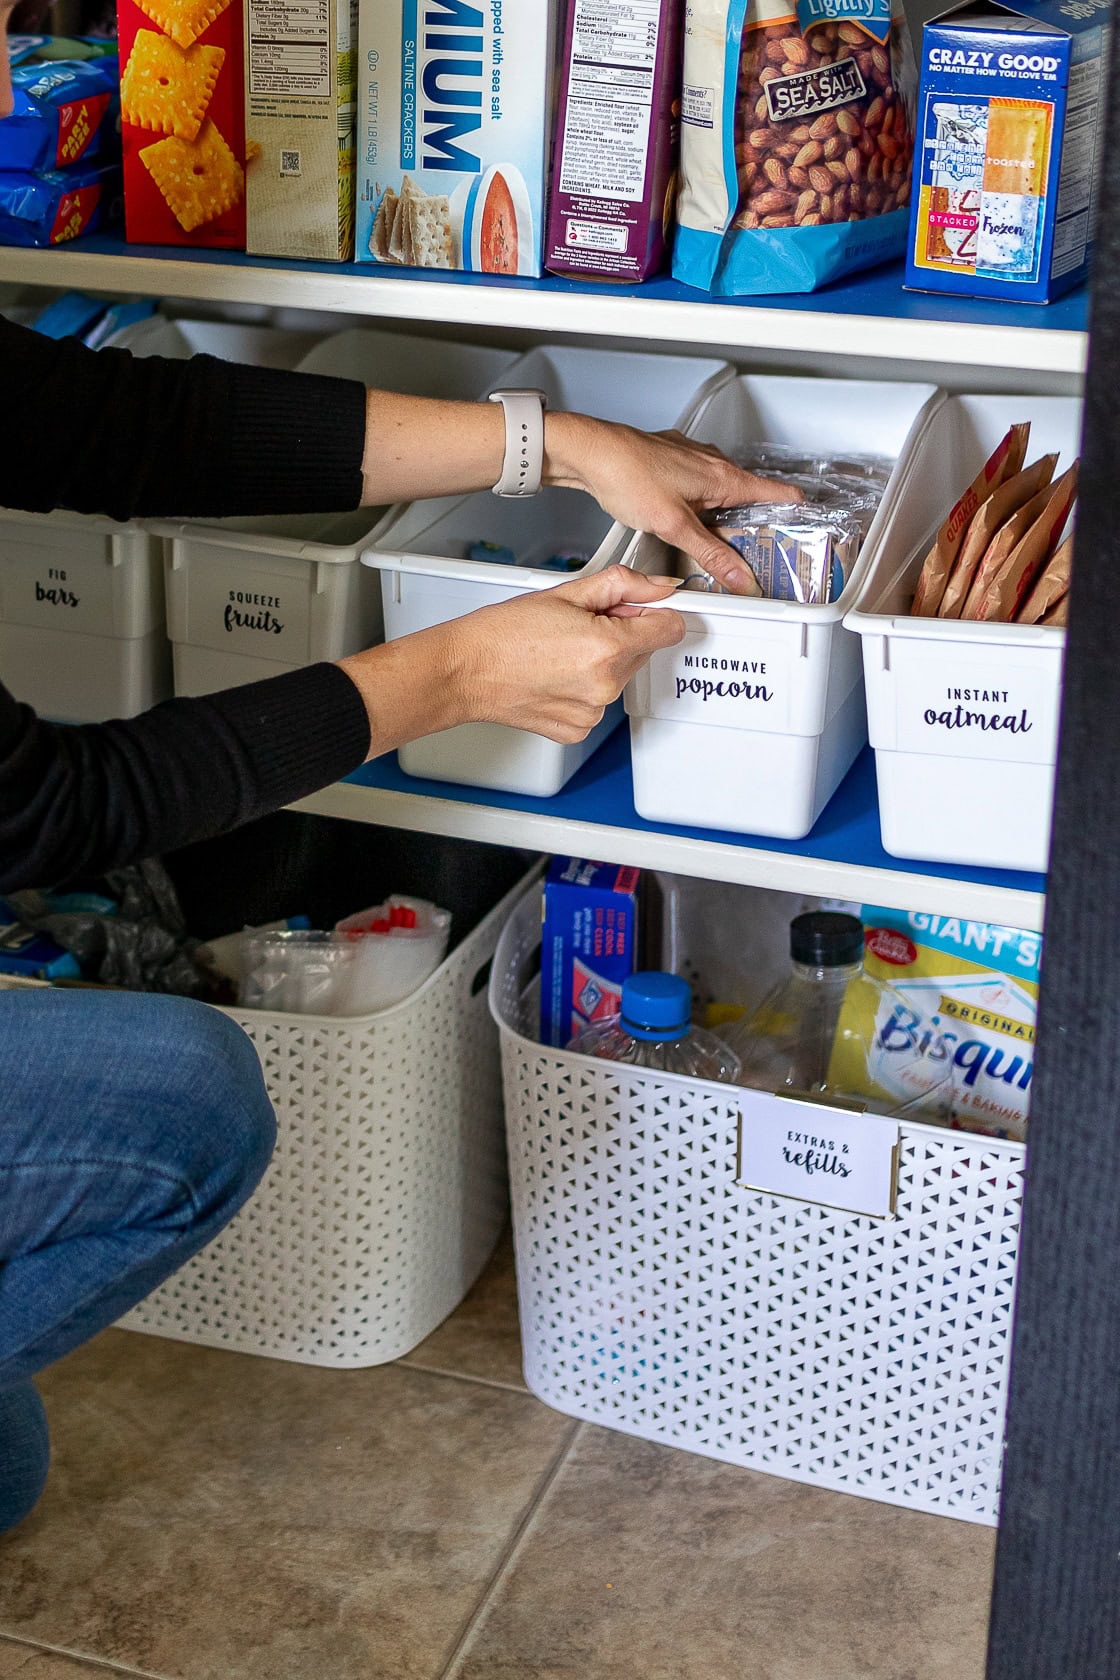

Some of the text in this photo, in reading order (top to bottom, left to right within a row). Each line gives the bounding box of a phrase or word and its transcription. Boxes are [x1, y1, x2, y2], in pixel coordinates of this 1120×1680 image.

[576, 14, 608, 22] Cholesterol
[590, 29, 627, 38] Carbohydrate
[491, 38, 504, 65] with
[928, 48, 994, 68] CRAZY
[491, 69, 502, 93] sea
[789, 66, 843, 86] MADE WITH
[928, 64, 943, 72] NO
[943, 65, 975, 75] MATTER
[976, 67, 997, 77] HOW
[999, 69, 1018, 78] YOU
[1018, 71, 1041, 80] LOVE
[368, 81, 378, 99] NET
[402, 40, 415, 159] SALTINE CRACKERS
[775, 70, 857, 109] SEA SALT
[367, 100, 378, 117] WT
[490, 96, 503, 121] salt
[594, 101, 613, 109] Enriched
[61, 104, 89, 158] PARTY
[69, 122, 90, 160] SIZE
[367, 124, 378, 138] LB
[365, 138, 378, 166] (453g)
[562, 179, 584, 187] CONTAINS
[570, 221, 593, 229] Questions
[929, 213, 977, 228] STACKED
[983, 215, 1026, 237] Frozen
[946, 492, 979, 544] QUAKER
[36, 581, 81, 608] bars
[229, 591, 281, 608] SQUEEZE
[224, 604, 284, 634] fruits
[684, 655, 767, 674] MICROWAVE
[676, 677, 774, 702] popcorn
[947, 688, 1009, 703] INSTANT
[924, 704, 1033, 734] oatmeal
[907, 911, 1012, 957] GIANT
[788, 1131, 835, 1151] EXTRAS
[782, 1146, 853, 1178] refills
